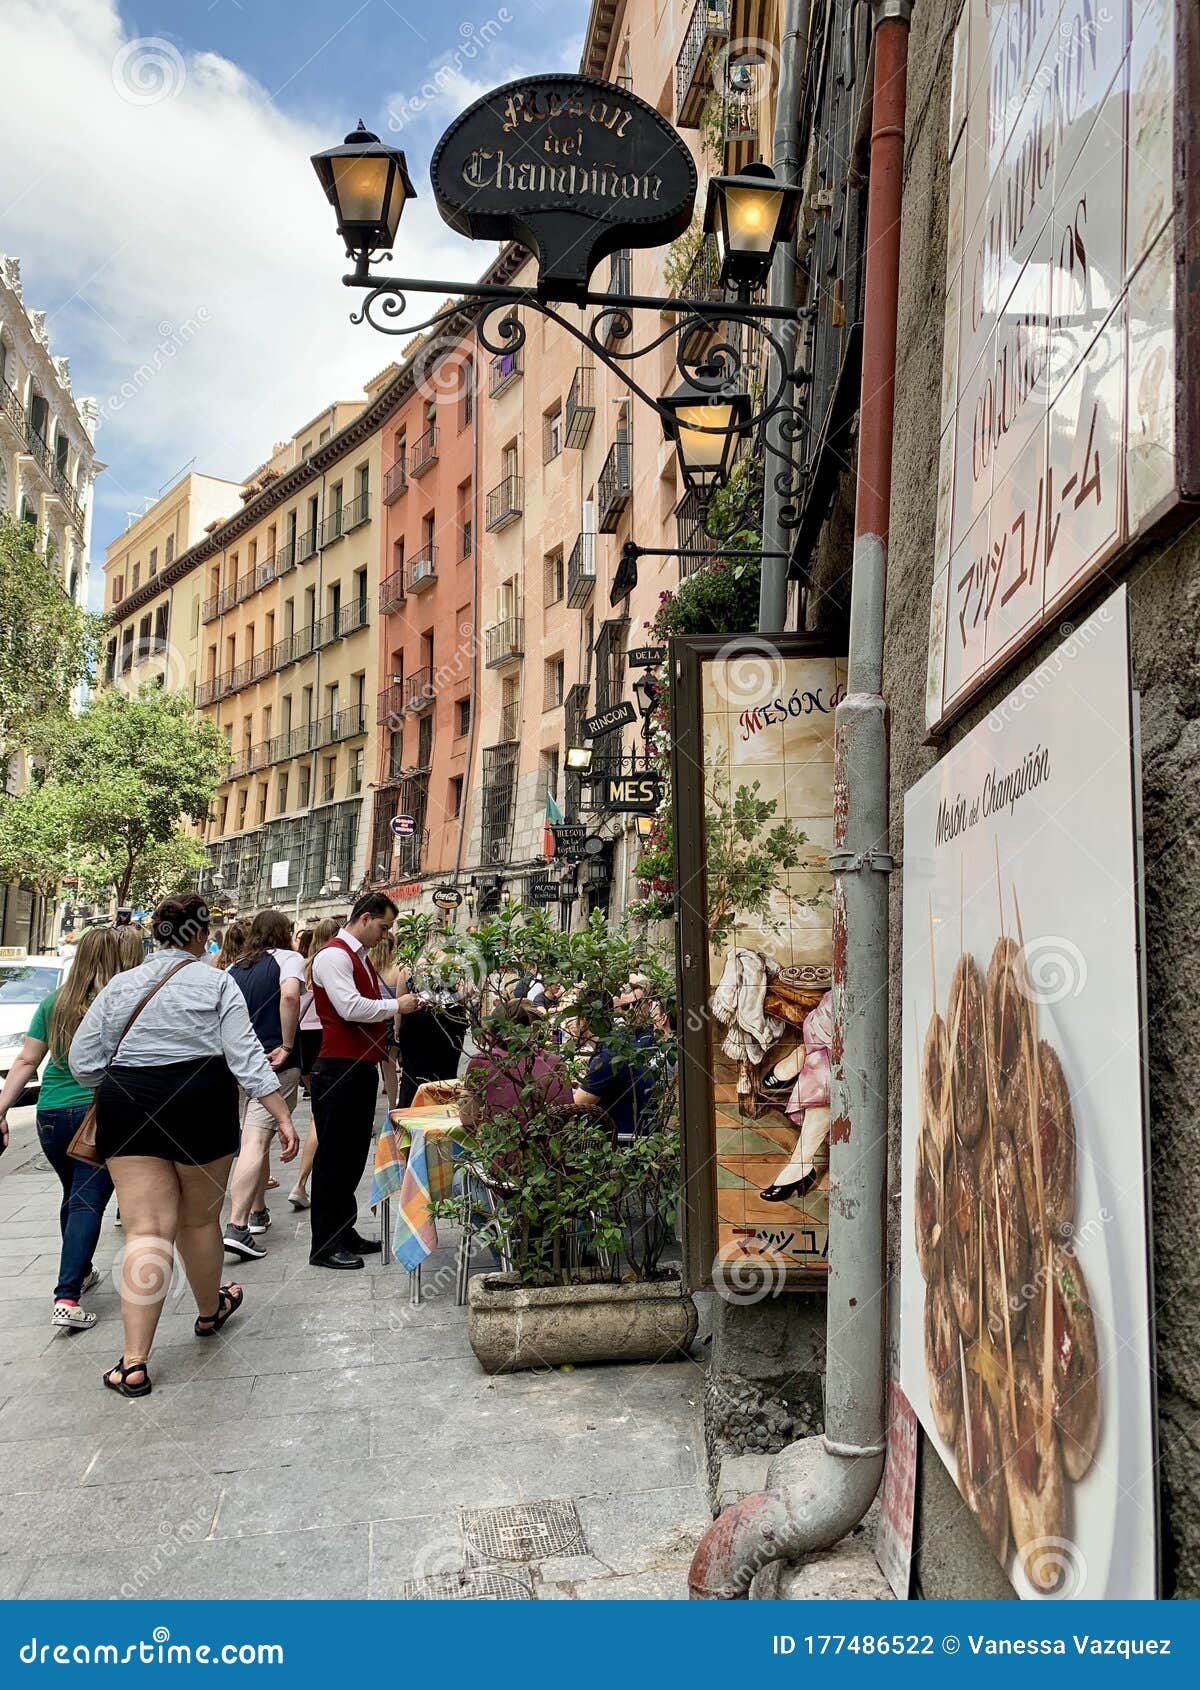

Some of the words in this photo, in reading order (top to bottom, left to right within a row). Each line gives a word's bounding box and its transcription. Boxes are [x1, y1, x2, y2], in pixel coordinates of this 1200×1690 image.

[544, 127, 583, 156] del
[636, 652, 648, 660] DE
[649, 652, 660, 660] LA
[589, 707, 628, 733] RINCON
[935, 794, 967, 848] Mesón
[969, 796, 980, 827] del
[982, 744, 1050, 817] Champiñón
